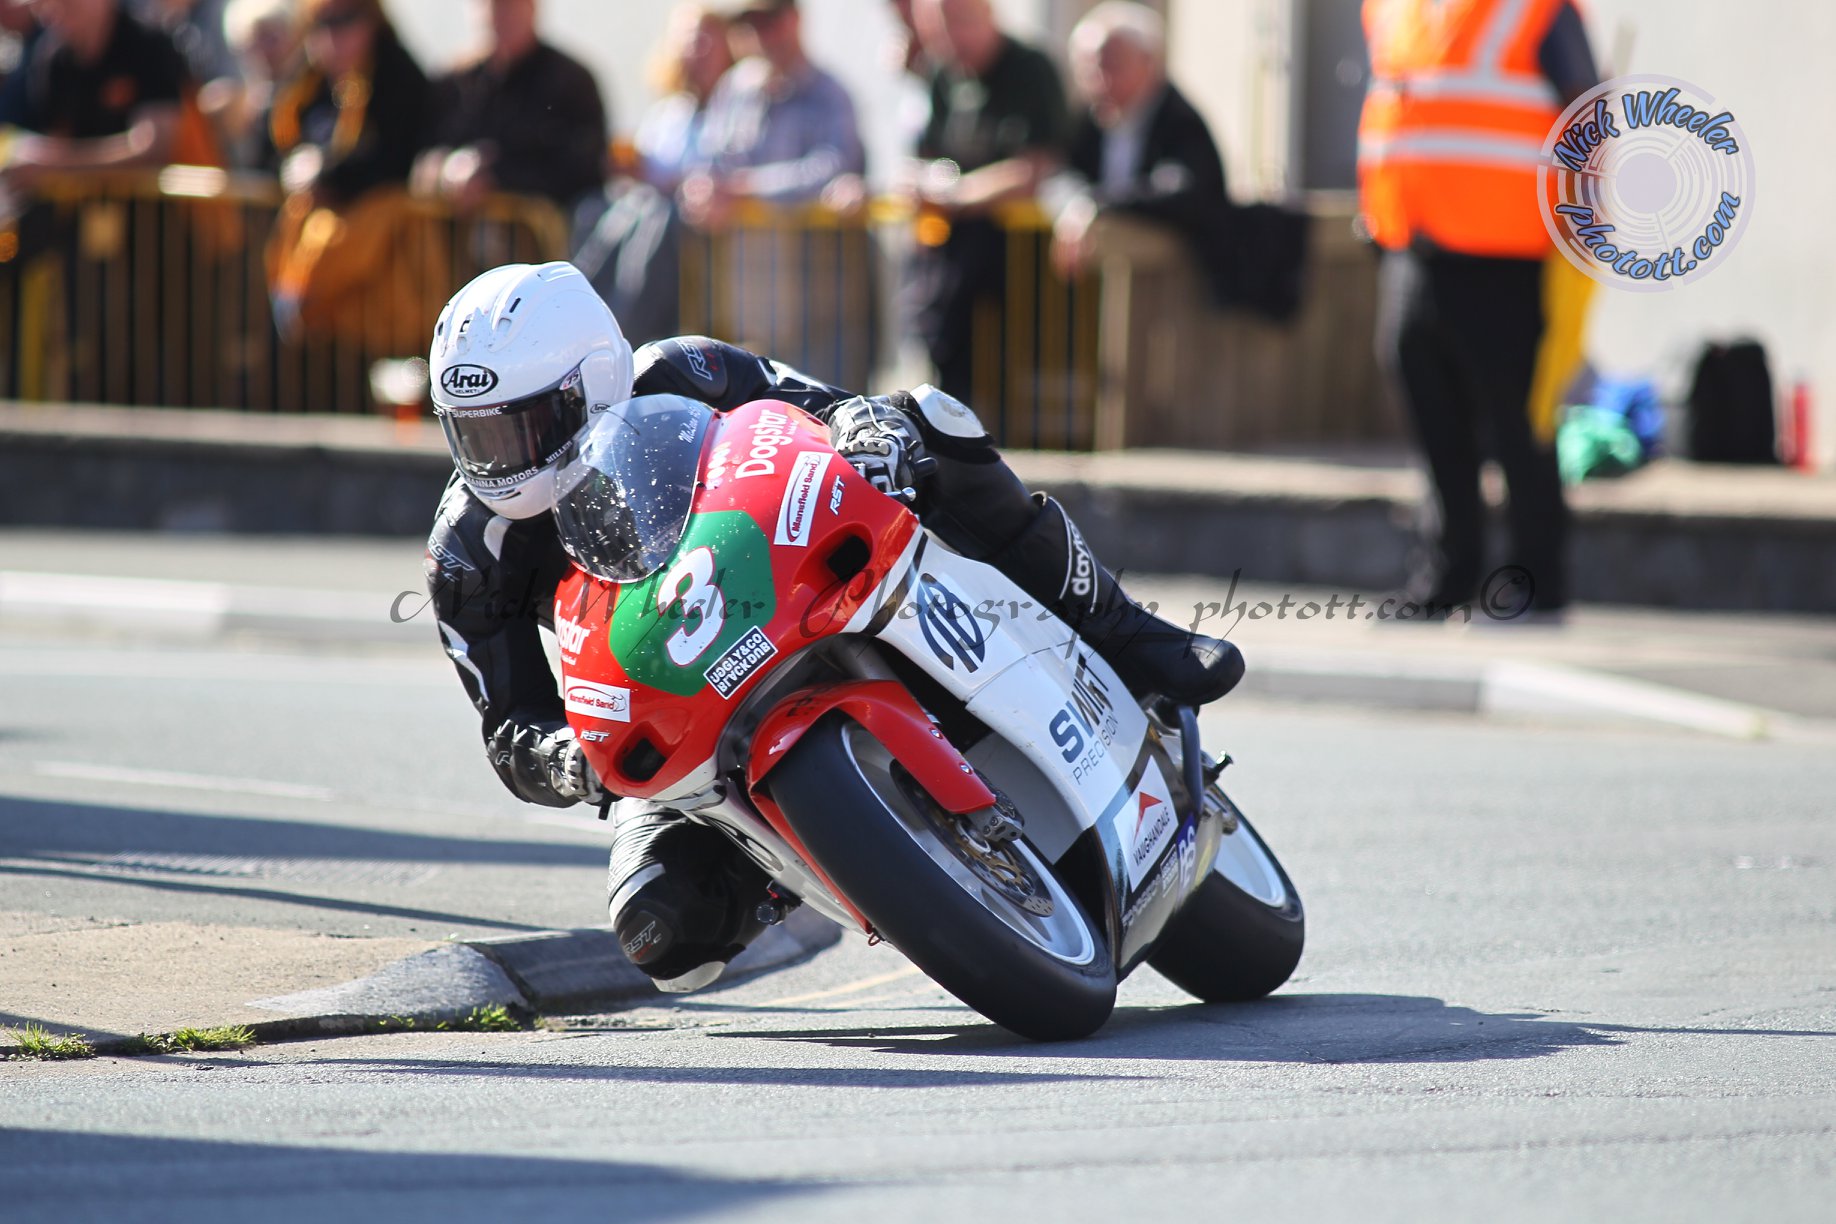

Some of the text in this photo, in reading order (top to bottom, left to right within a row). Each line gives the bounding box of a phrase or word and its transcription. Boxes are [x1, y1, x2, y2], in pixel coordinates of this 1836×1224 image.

[442, 367, 490, 388] Arai
[452, 406, 502, 418] SUPERBIKE
[735, 409, 793, 479] Dogstar
[496, 466, 539, 488] MOTORS
[791, 463, 818, 532] Mansfield Sand
[829, 474, 846, 516] RST
[657, 546, 726, 667] 3
[595, 698, 615, 710] Sand
[580, 729, 611, 742] RST
[1072, 716, 1119, 786] PRECISION
